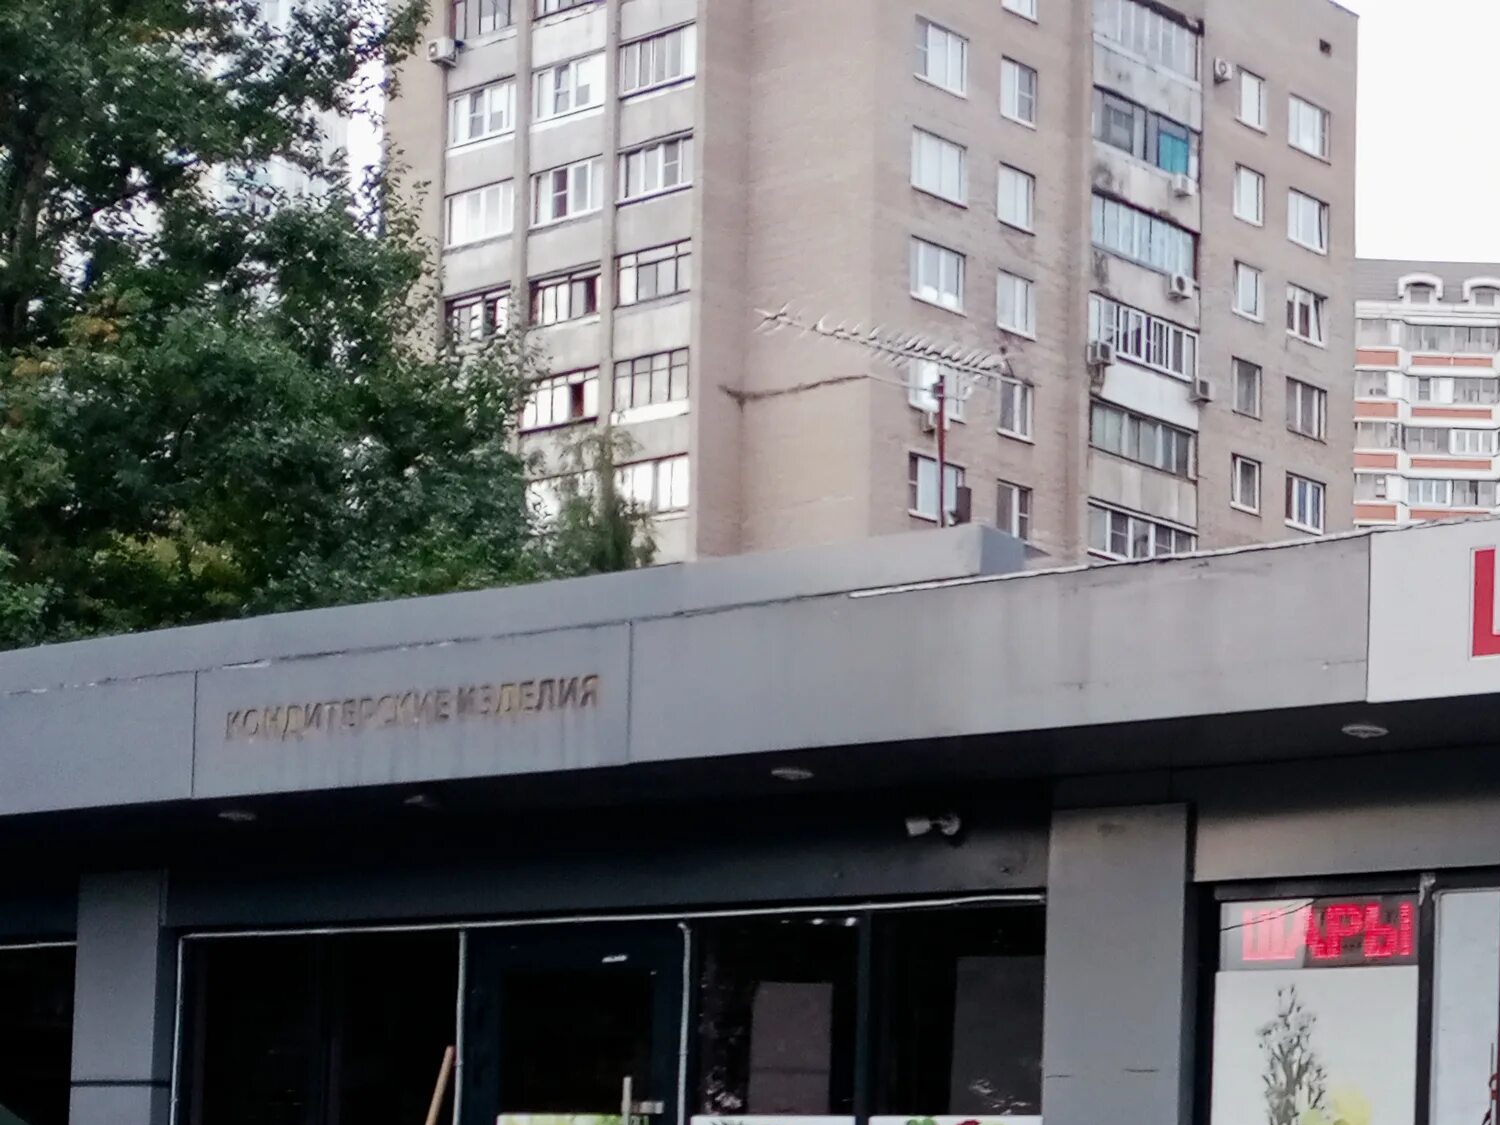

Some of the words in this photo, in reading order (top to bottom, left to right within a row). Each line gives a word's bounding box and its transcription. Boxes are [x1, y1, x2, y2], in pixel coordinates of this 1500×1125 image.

[225, 688, 451, 742] КОНДИТЕРСКИЕ
[456, 674, 600, 716] ИЗДЕЛИЯ
[1242, 901, 1414, 962] ШАРЫ
